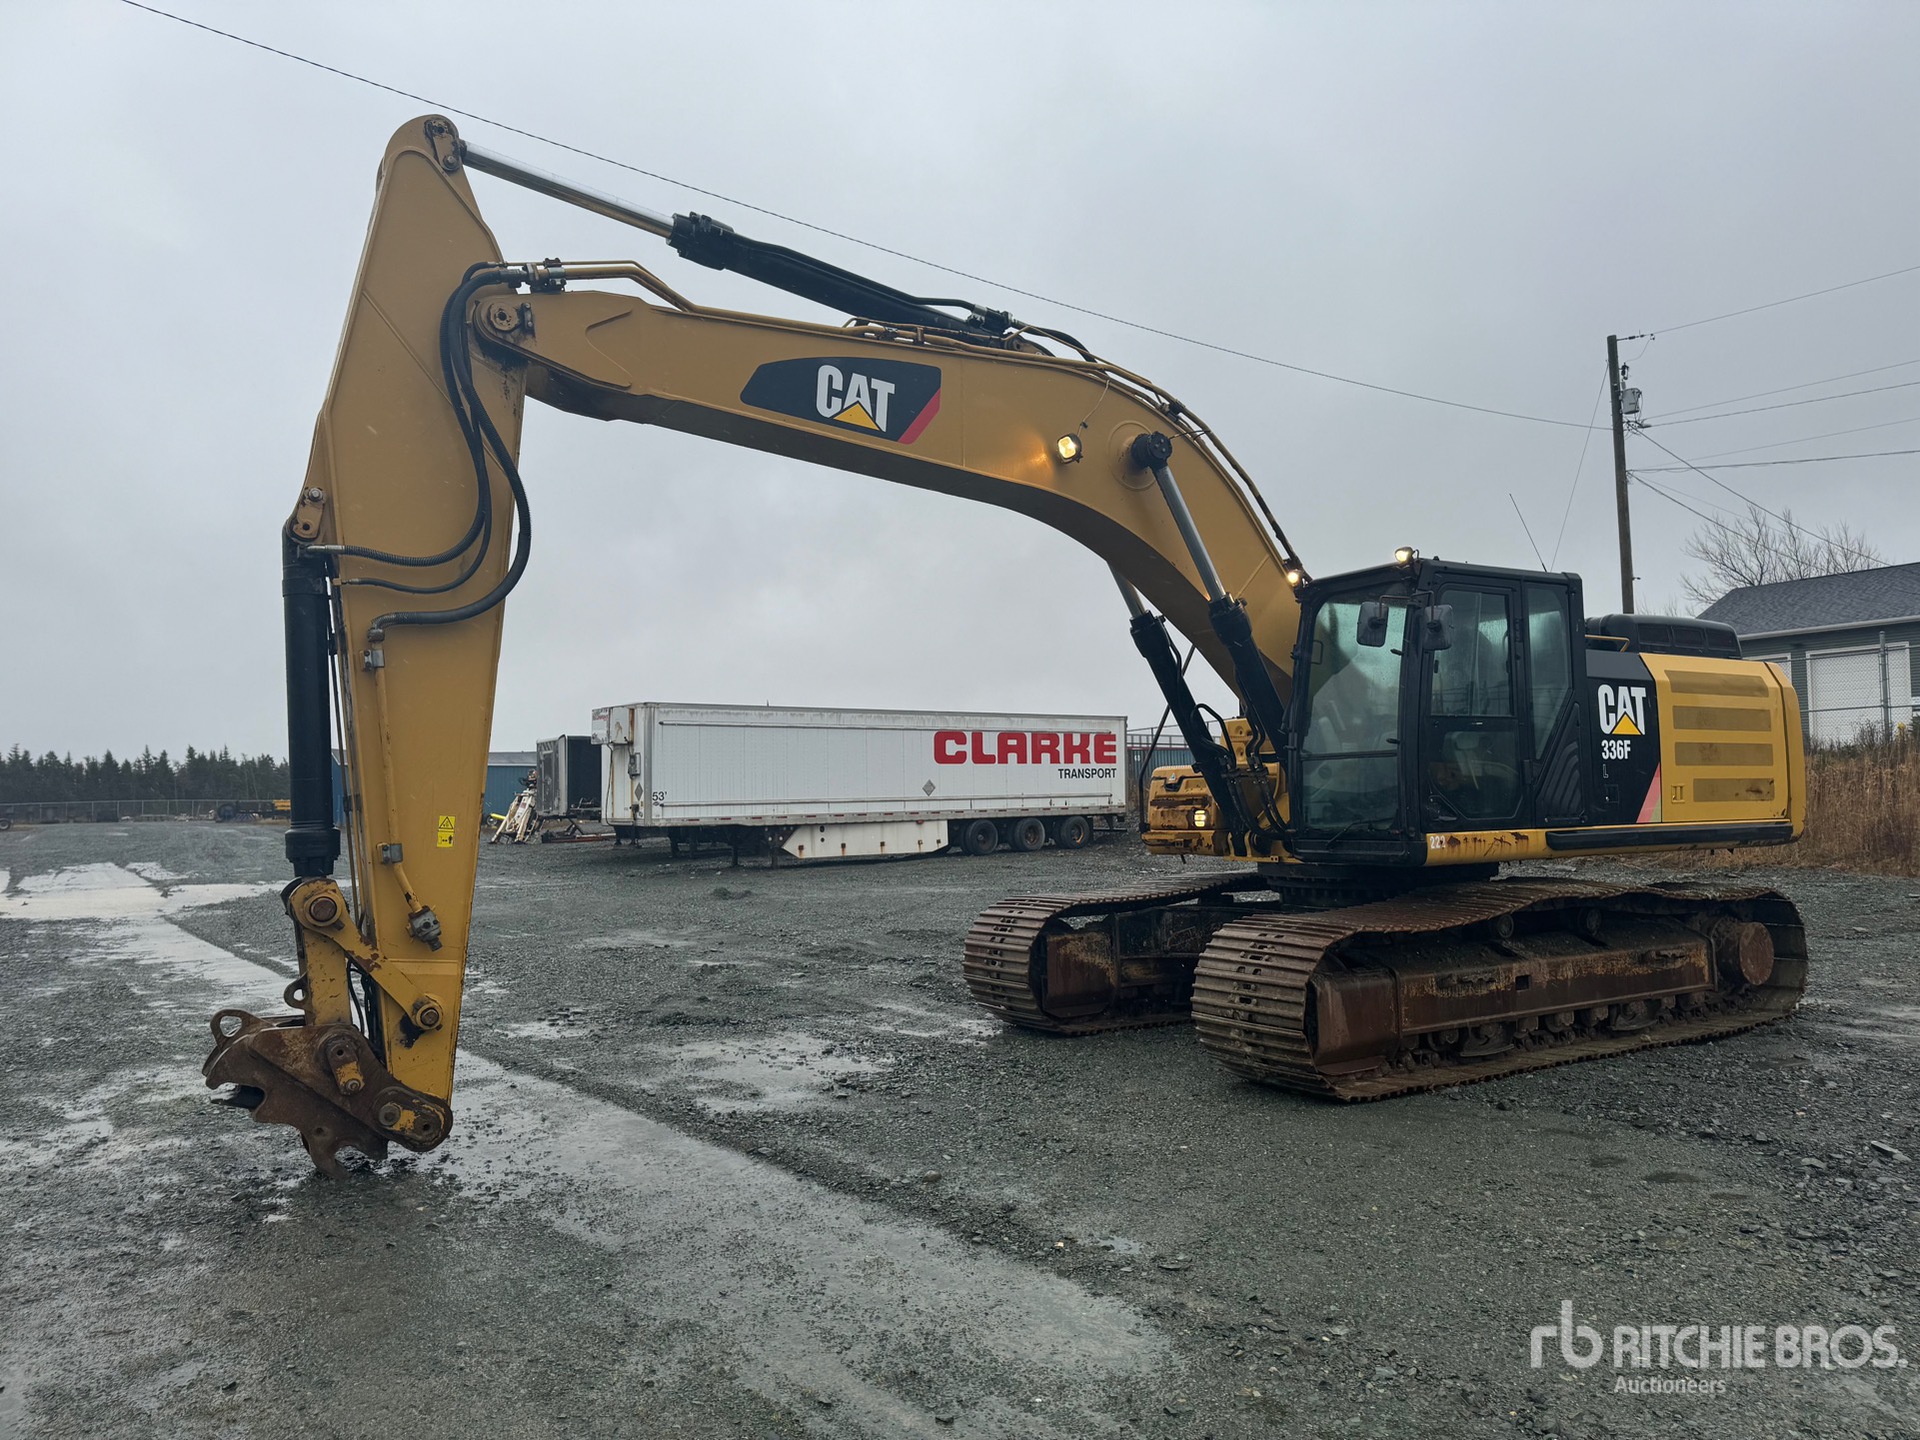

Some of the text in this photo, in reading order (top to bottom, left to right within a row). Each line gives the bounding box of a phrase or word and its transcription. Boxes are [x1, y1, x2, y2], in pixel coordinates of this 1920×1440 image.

[816, 364, 895, 432] CAT
[1598, 684, 1647, 735] CAT
[934, 730, 1117, 764] CLARKE
[1601, 739, 1631, 760] 336F
[1058, 768, 1117, 779] TRANSPORT
